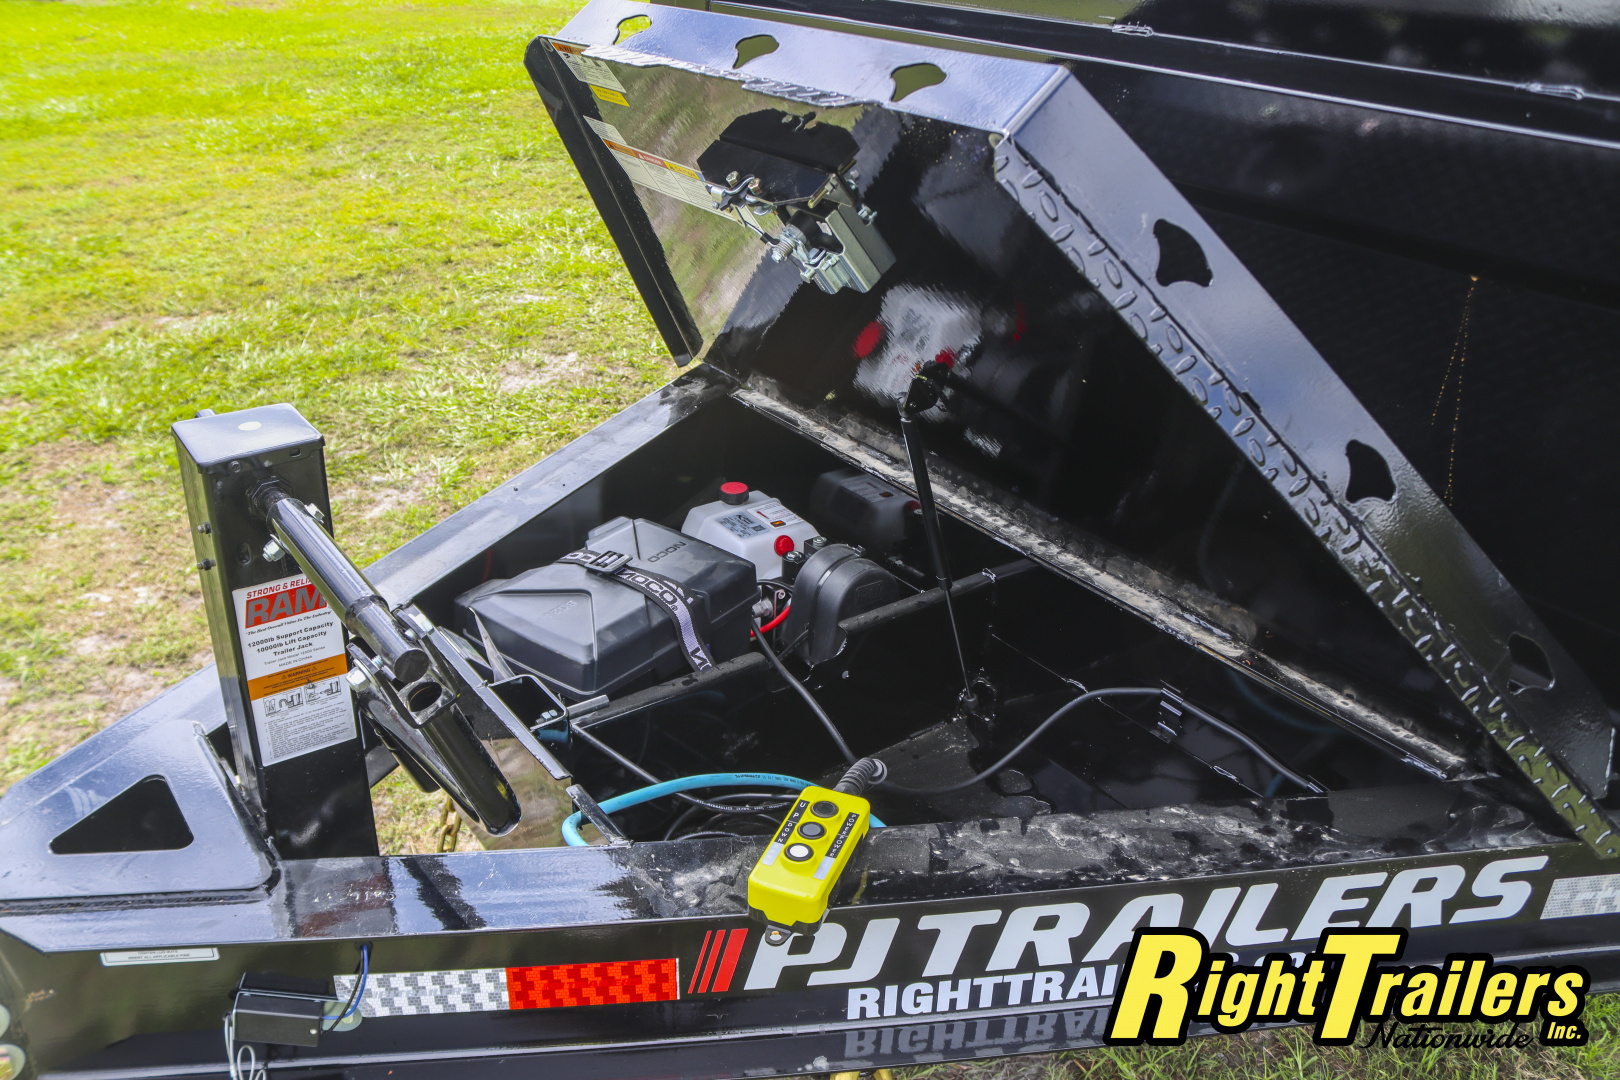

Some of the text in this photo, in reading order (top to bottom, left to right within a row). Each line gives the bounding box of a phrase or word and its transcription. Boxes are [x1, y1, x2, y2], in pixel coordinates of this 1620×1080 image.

[647, 541, 687, 563] NOCO
[246, 583, 282, 599] STRONG
[282, 581, 289, 590] &
[246, 586, 327, 627] RAM
[248, 621, 334, 648] 12000lb Support Capacity
[257, 630, 328, 653] 10000lb Lift Capacity
[273, 642, 313, 657] Trailer Jack
[298, 654, 313, 663] CHINA
[287, 667, 311, 678] WARNING
[777, 822, 792, 843] DOWN
